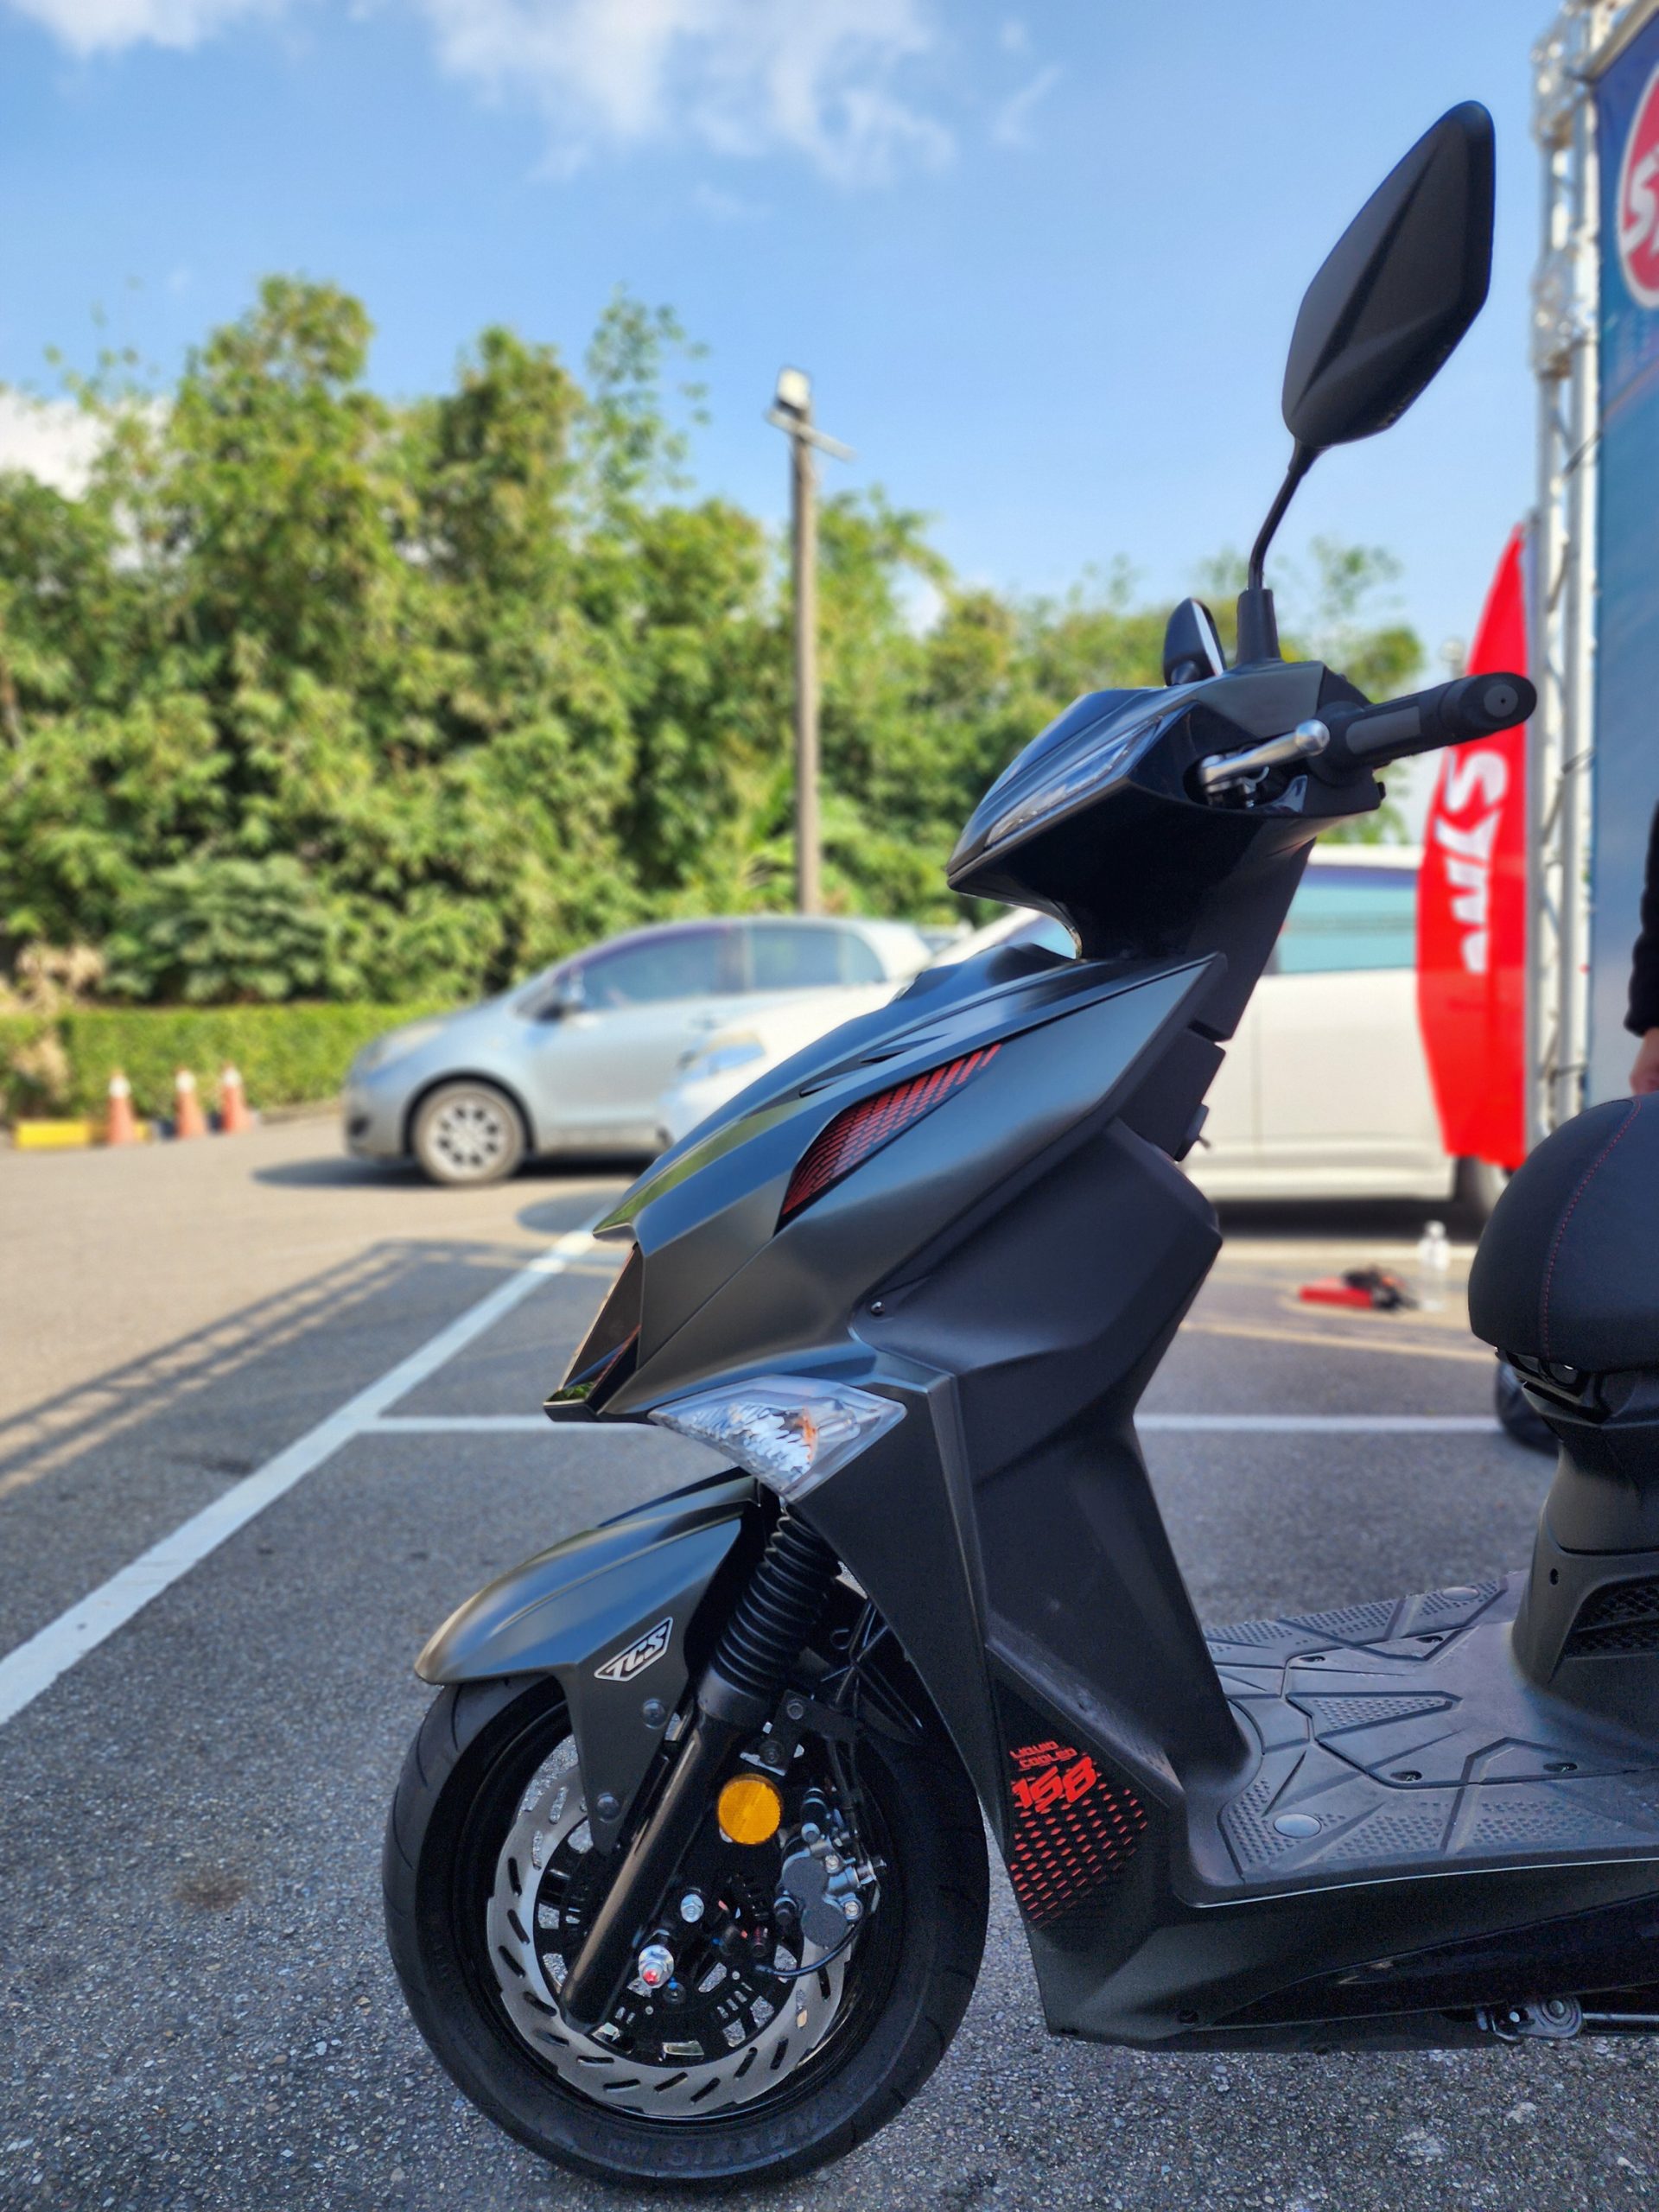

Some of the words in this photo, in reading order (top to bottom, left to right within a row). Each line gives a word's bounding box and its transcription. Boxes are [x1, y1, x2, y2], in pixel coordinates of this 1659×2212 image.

[1434, 748, 1509, 974] SYM
[604, 1624, 668, 1680] TCS
[1009, 1740, 1059, 1759] LIQUID
[1019, 1747, 1077, 1770] COOLED
[1012, 1756, 1097, 1813] 158
